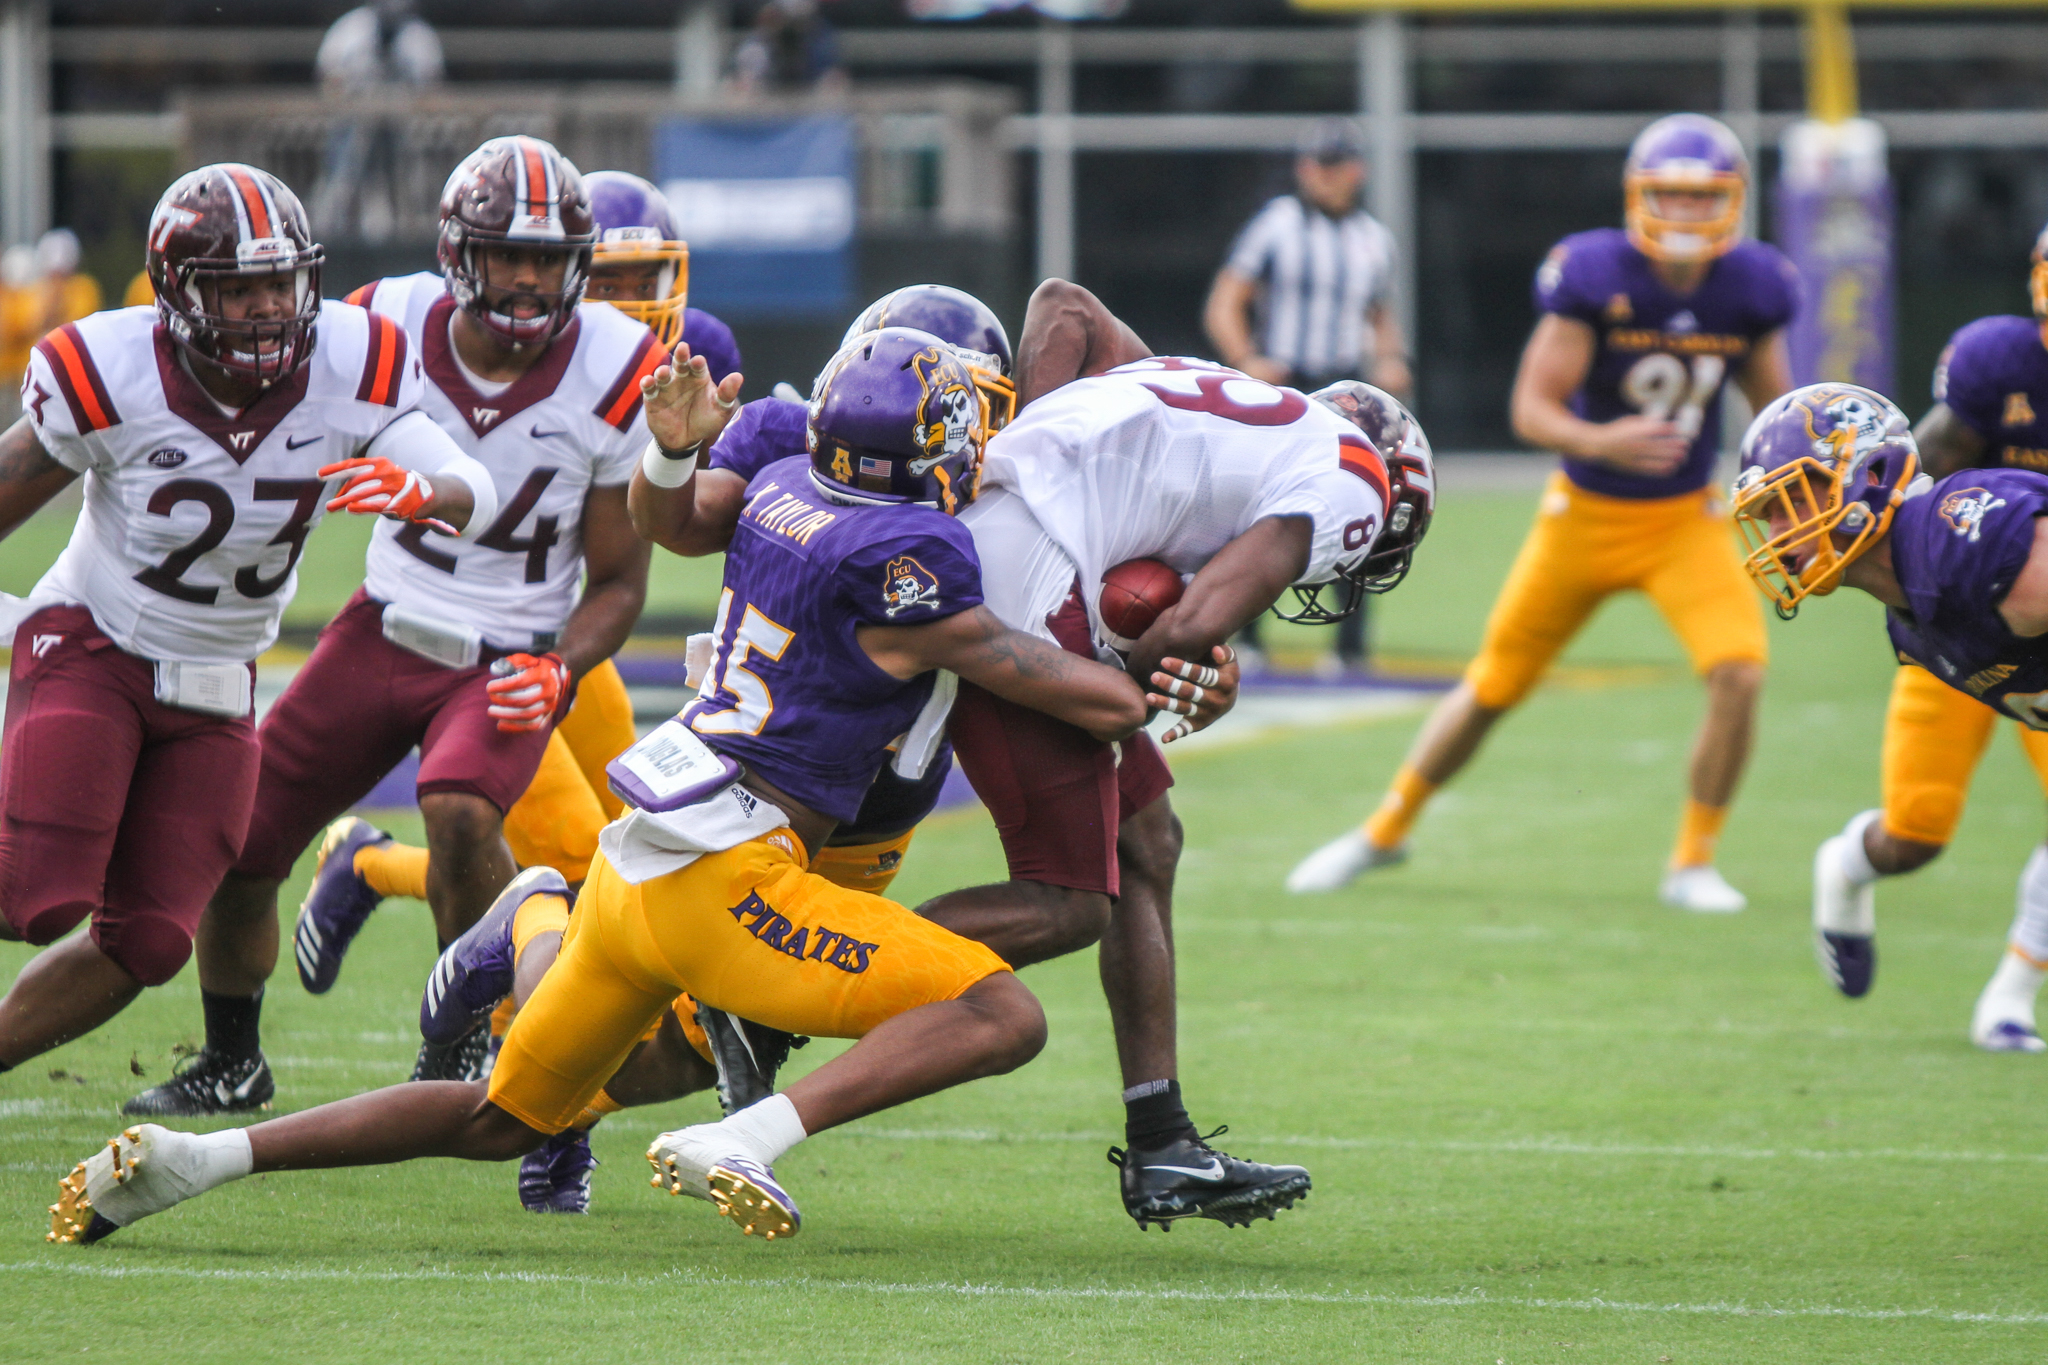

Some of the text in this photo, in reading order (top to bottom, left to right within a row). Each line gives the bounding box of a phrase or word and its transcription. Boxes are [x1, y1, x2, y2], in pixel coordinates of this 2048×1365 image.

[254, 241, 280, 251] ACC
[621, 228, 644, 240] ECU
[930, 362, 960, 387] ECU
[1620, 352, 1726, 436] 91
[473, 407, 501, 427] VT
[229, 430, 257, 449] VT
[150, 450, 184, 464] ACC
[755, 492, 837, 546] TAYLOR
[132, 477, 327, 605] 23
[893, 564, 911, 578] ECU
[32, 633, 65, 659] VT
[677, 586, 797, 737] 15
[731, 787, 754, 819] adidas
[728, 886, 880, 974] PIRATES
